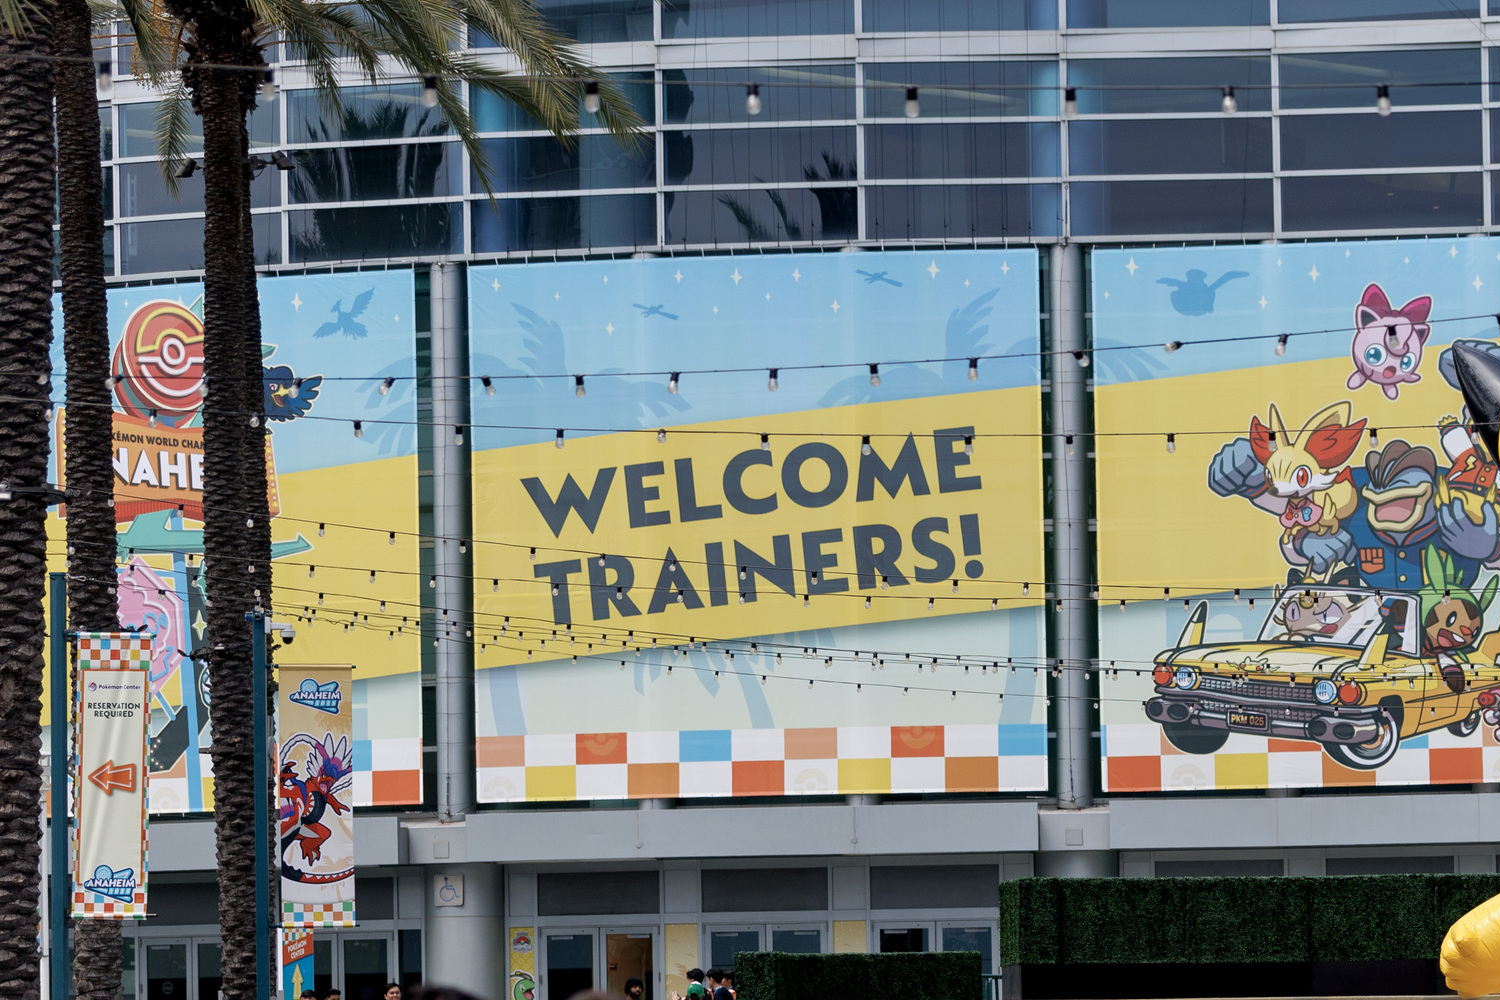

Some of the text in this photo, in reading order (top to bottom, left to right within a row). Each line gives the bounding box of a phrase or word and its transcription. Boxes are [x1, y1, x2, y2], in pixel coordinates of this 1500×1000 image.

[146, 435, 178, 447] WORLD
[520, 426, 982, 539] WELCOME
[533, 513, 984, 626] TRAINERS!
[293, 691, 340, 700] ANAHEIM
[94, 710, 134, 719] REQUIRED
[1230, 713, 1265, 726] PKM 025
[87, 878, 135, 888] ANAHEIM
[287, 939, 307, 953] POKÉMON
[290, 948, 305, 959] CENTER
